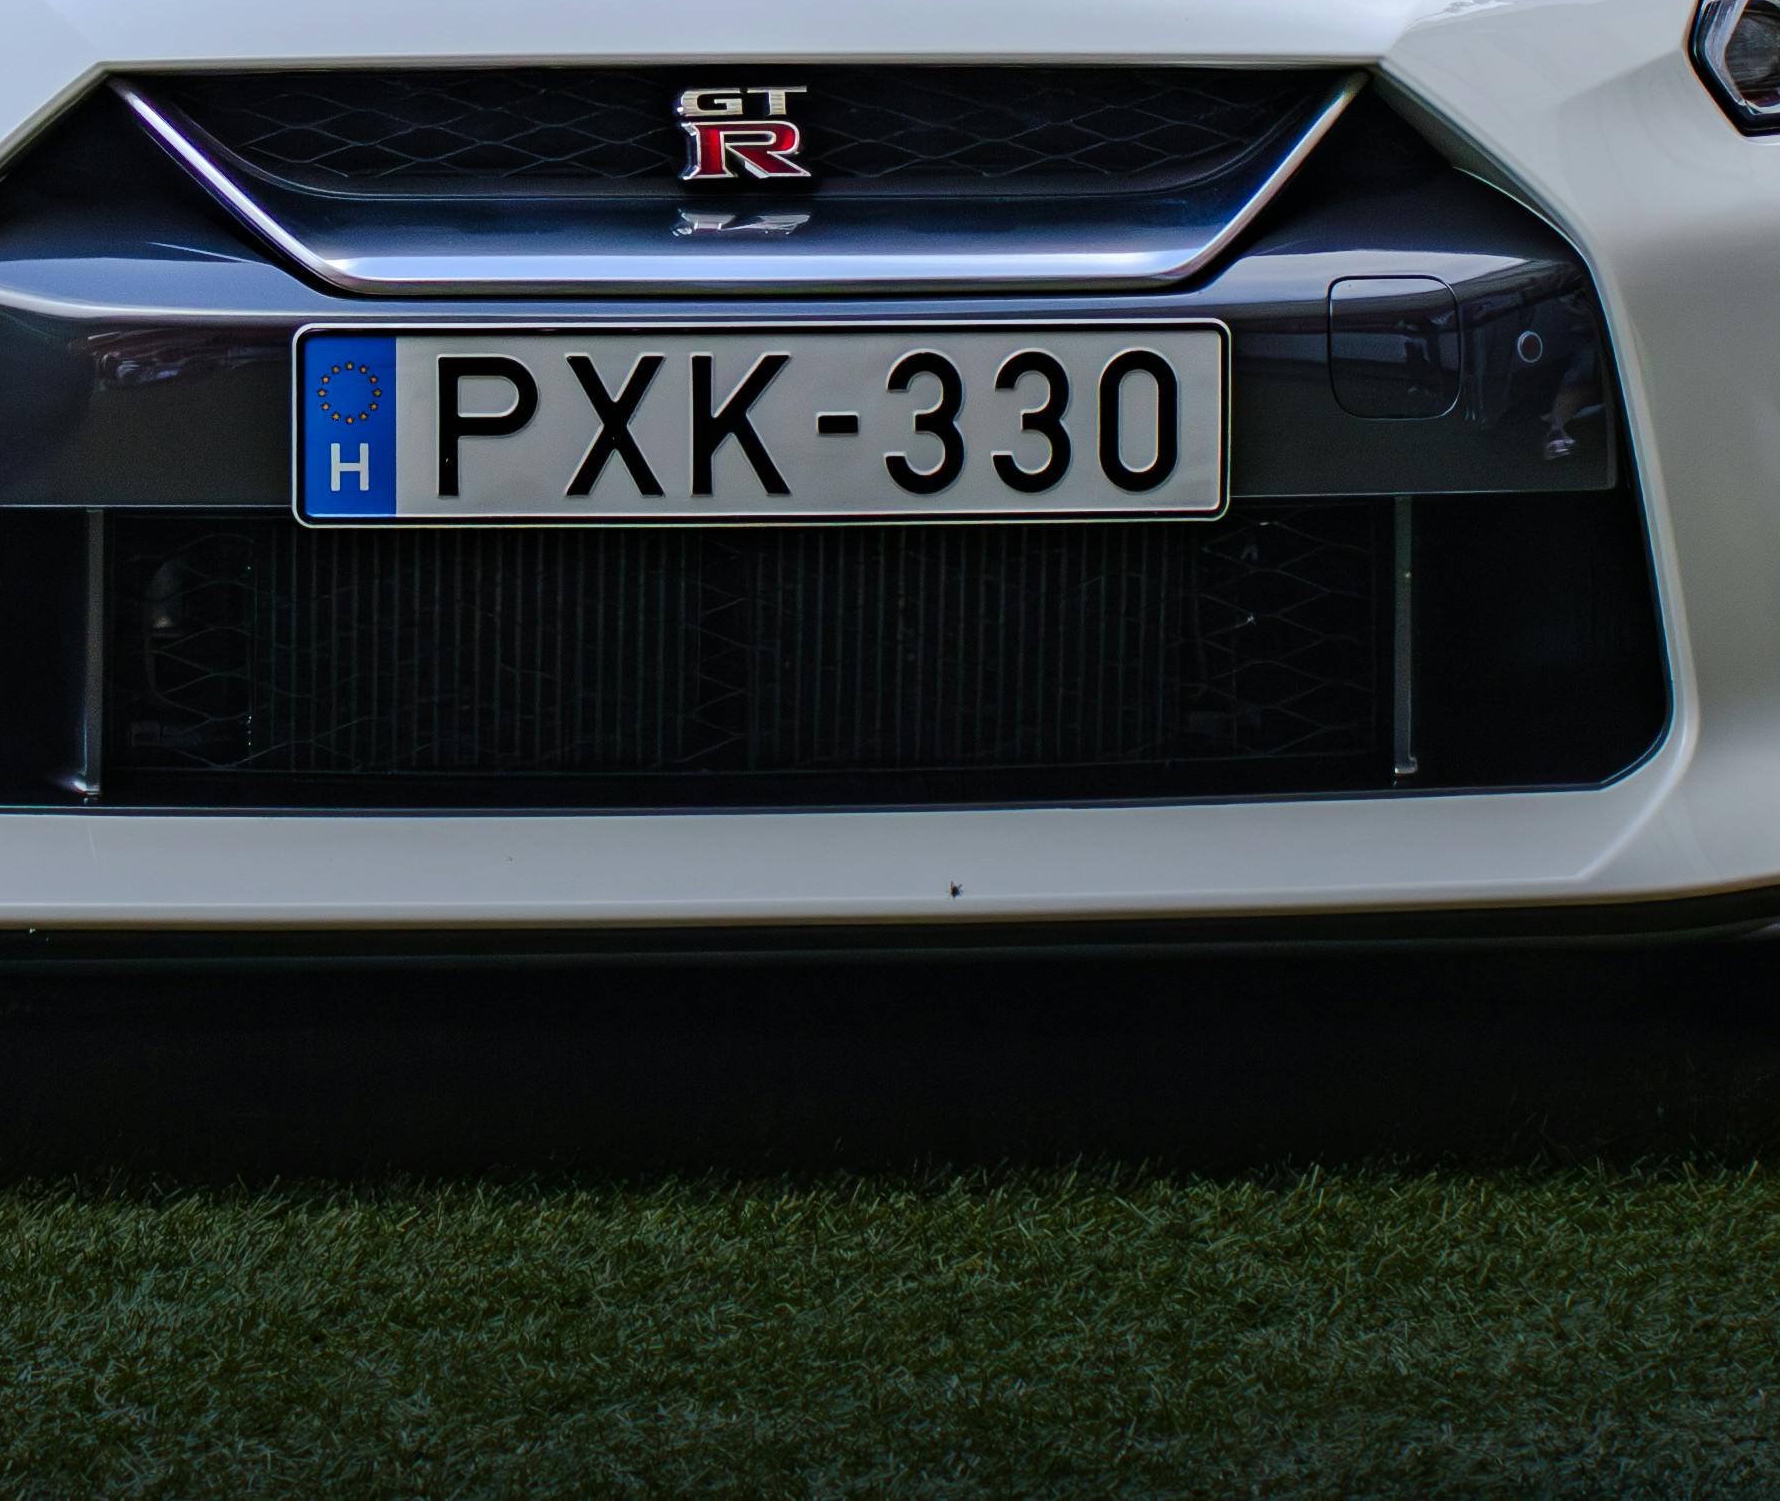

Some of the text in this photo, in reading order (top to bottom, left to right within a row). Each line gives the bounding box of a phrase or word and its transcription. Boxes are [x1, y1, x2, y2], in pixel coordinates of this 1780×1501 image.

[677, 86, 808, 116] GT
[679, 120, 812, 180] R
[329, 348, 1180, 498] H PXK-330
